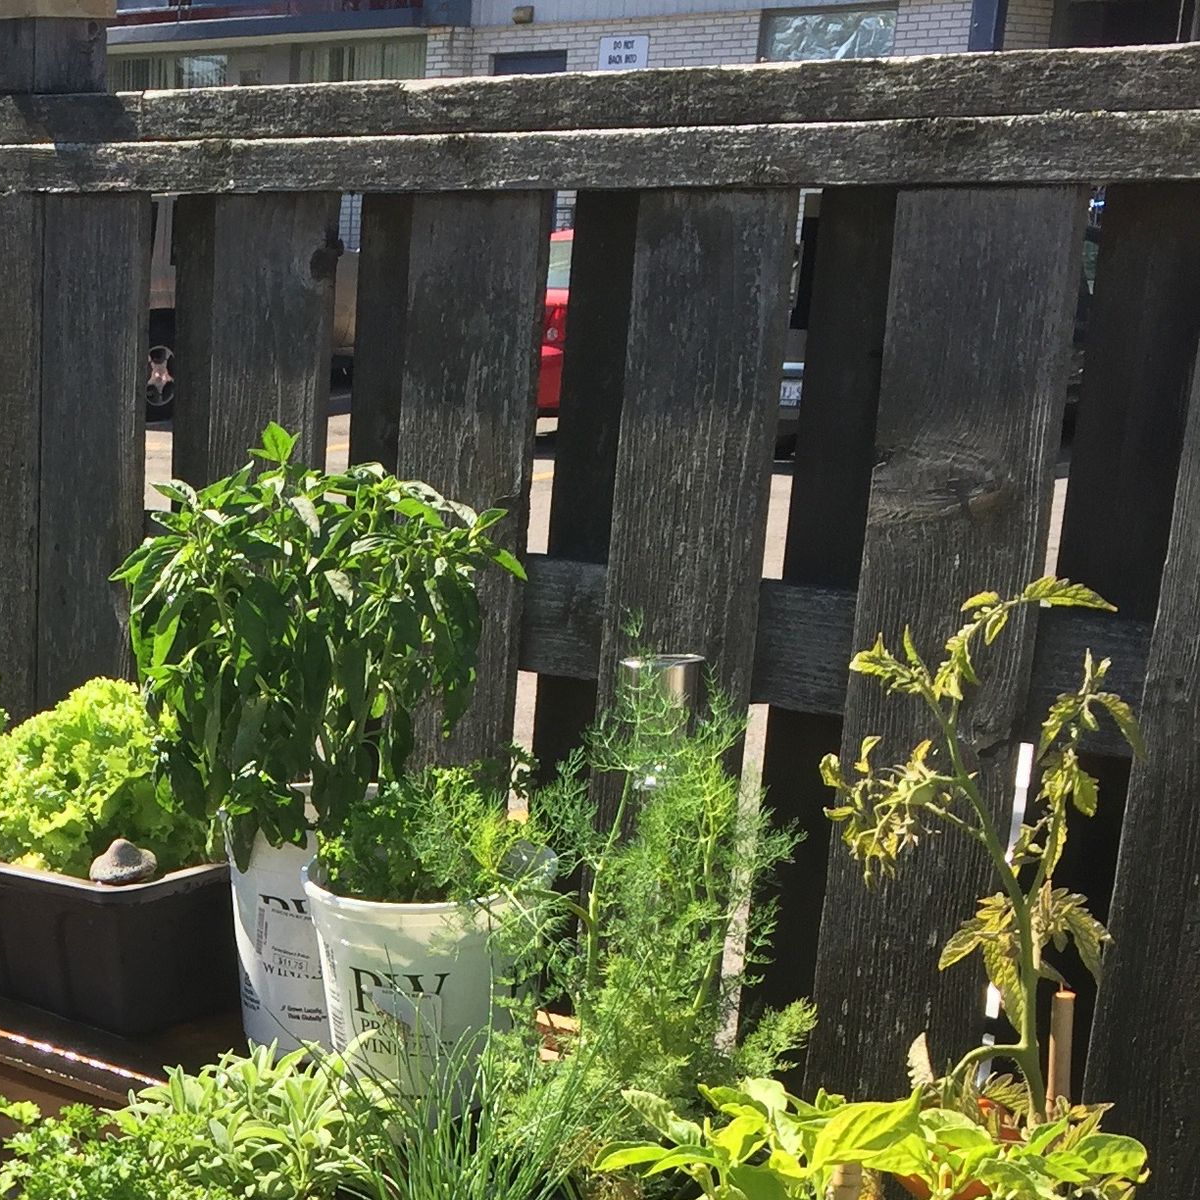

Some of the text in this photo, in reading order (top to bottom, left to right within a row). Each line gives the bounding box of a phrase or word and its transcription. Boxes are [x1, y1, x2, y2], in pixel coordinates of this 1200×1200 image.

[614, 40, 635, 50] DO NOT
[608, 55, 623, 65] BACK
